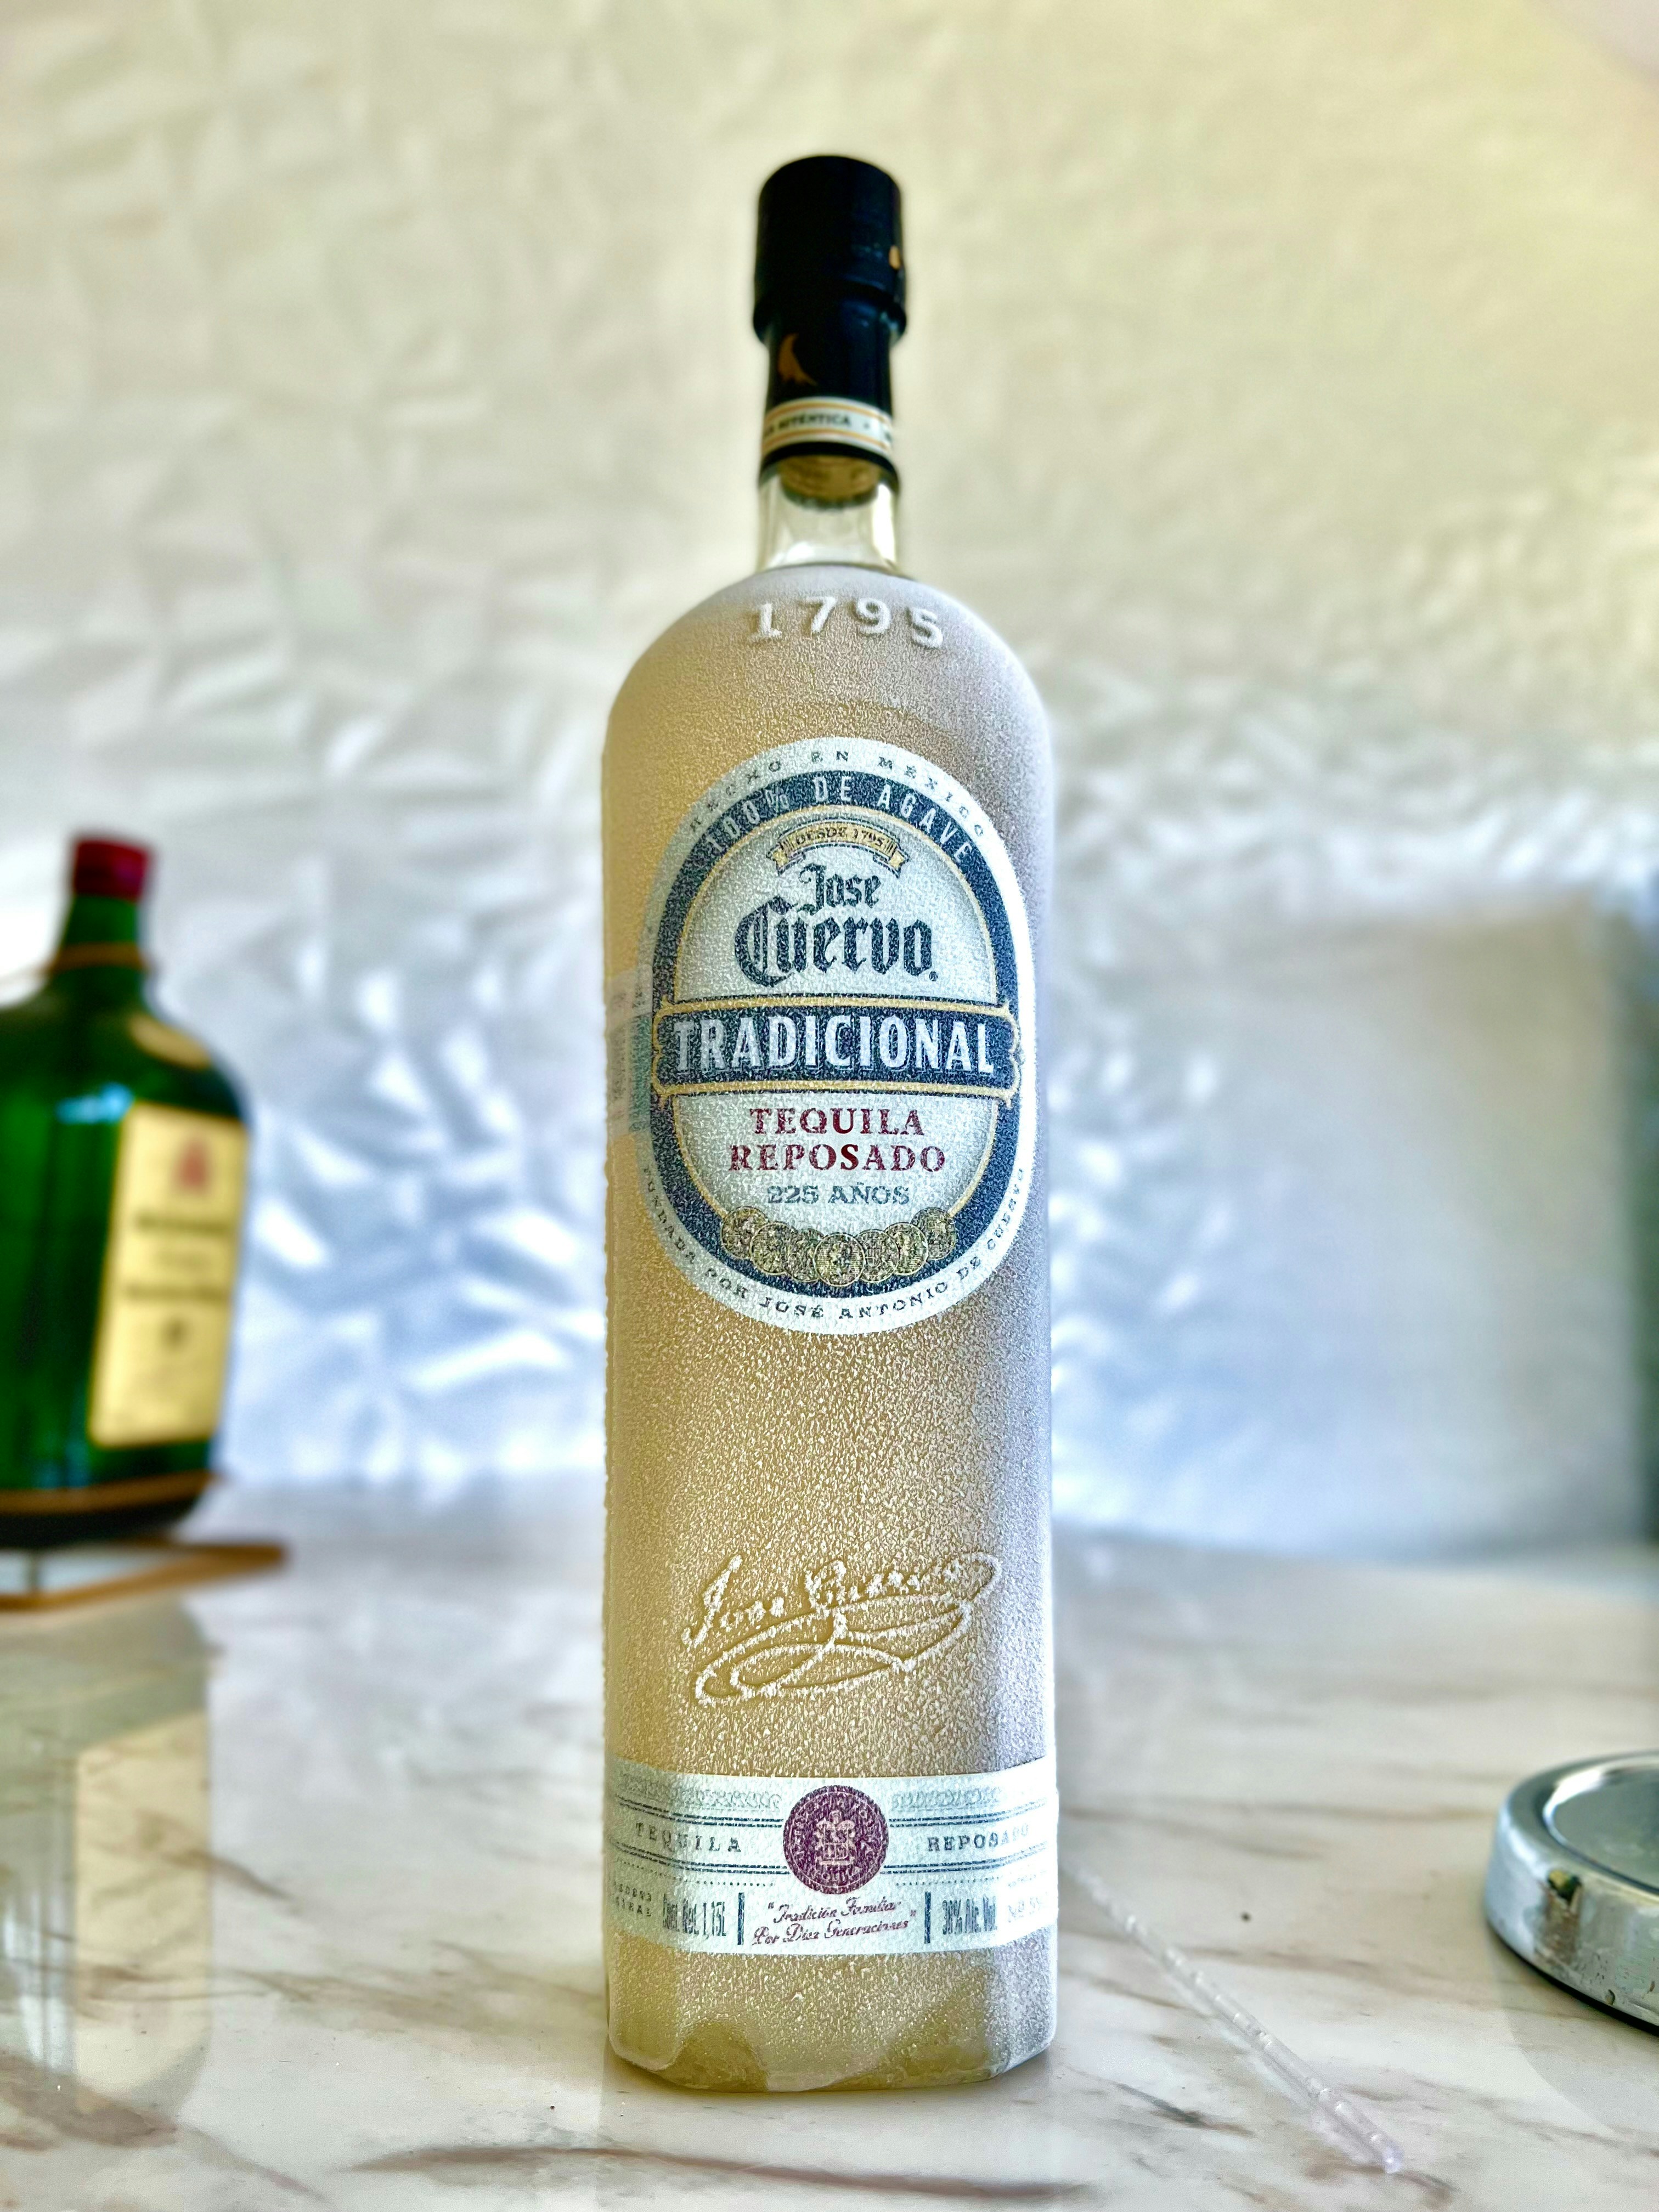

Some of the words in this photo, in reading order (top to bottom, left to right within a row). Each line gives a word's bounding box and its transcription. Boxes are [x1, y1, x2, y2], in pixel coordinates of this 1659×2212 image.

[747, 596, 944, 648] 1795
[706, 786, 790, 851] 100%
[813, 775, 853, 803] DE
[877, 783, 973, 864] AGAVE
[735, 895, 933, 988] Cuervo
[673, 1014, 995, 1074] TRADICIONAL
[749, 1107, 925, 1135] TEQUILA
[729, 1144, 946, 1172] REPOSADO
[768, 1186, 819, 1204] 225
[827, 1181, 910, 1205] AÑOS
[759, 1296, 824, 1318] JOSÉ
[839, 1282, 948, 1319] ANTONIO
[635, 1821, 742, 1852] TEQUILA
